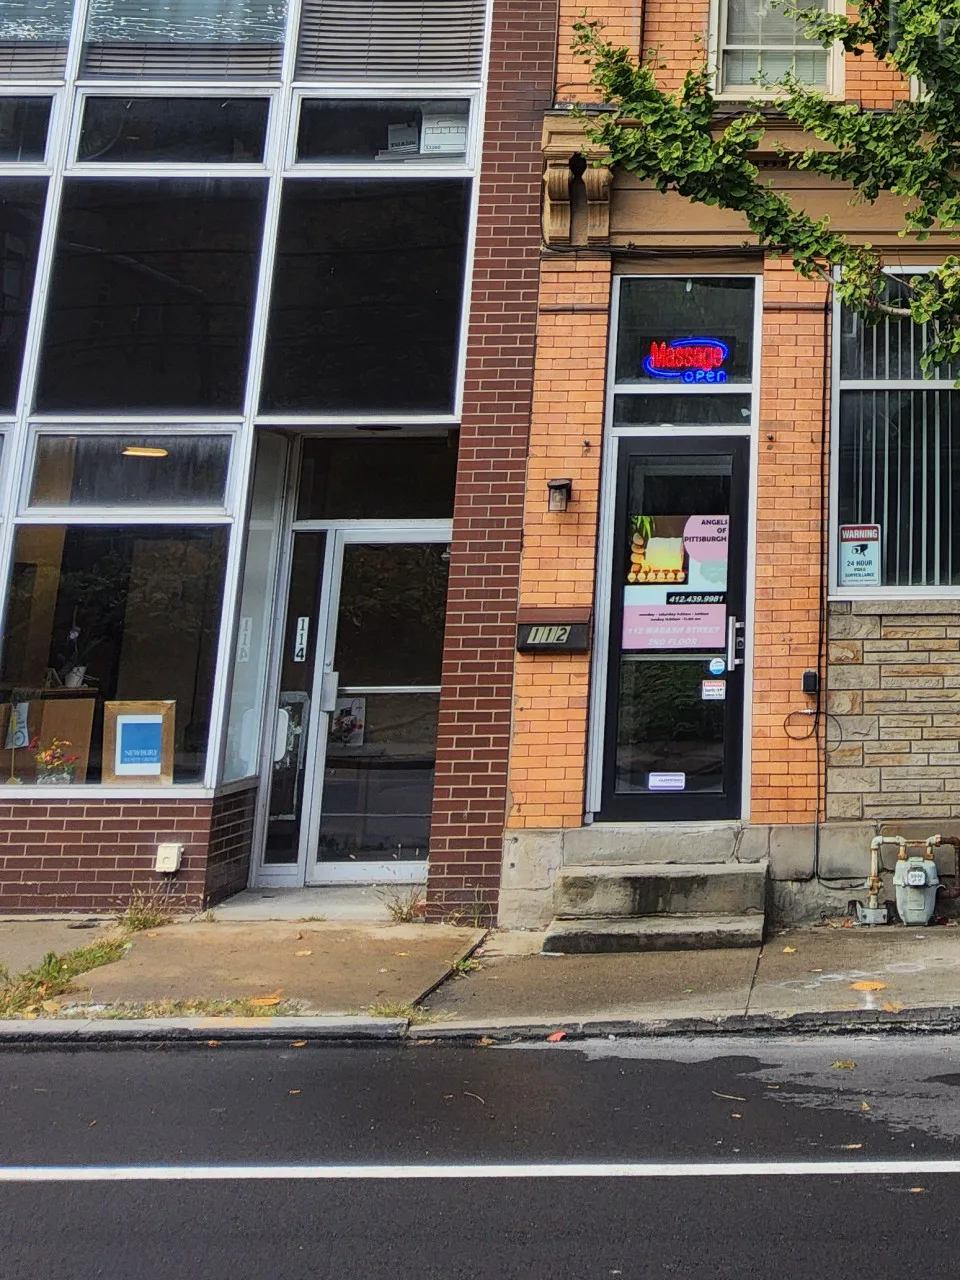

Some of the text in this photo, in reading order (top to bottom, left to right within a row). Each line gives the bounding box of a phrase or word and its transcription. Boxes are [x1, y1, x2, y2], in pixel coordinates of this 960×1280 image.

[650, 340, 723, 371] Massage
[842, 529, 878, 539] WARNING
[669, 595, 724, 603] 412.439.9981
[295, 618, 306, 661] 114
[532, 627, 568, 642] 112
